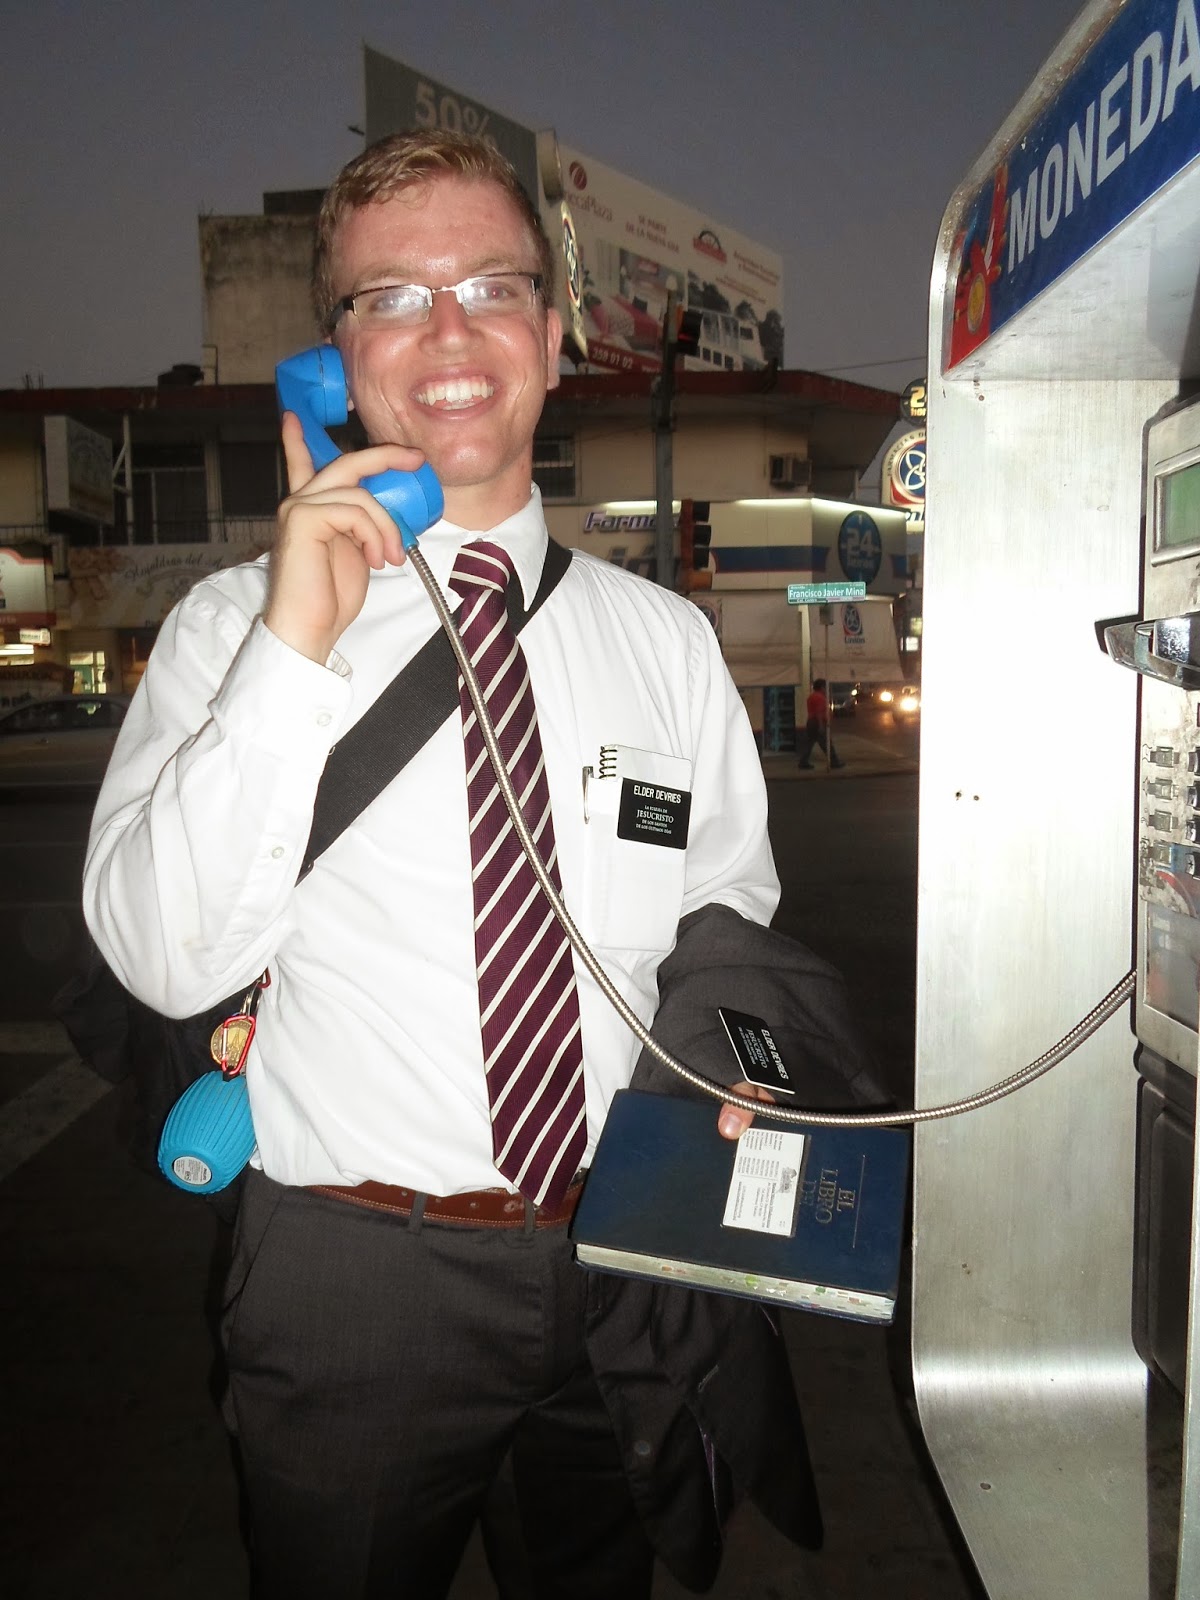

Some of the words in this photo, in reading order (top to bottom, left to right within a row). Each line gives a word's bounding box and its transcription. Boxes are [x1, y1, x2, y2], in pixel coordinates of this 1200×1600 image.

[1007, 0, 1200, 272] MONEDA
[910, 386, 926, 408] 2
[847, 528, 873, 557] 24
[789, 588, 822, 599] Francisco
[823, 588, 844, 598] Javier
[846, 587, 864, 596] Mina
[634, 785, 654, 798] ELDER
[655, 790, 682, 804] DEVRIES
[636, 810, 674, 824] JESUCRISTO
[761, 1029, 776, 1051] ELDER
[771, 1051, 789, 1080] DEVRIES
[815, 1168, 839, 1224] LIBRO
[836, 1187, 856, 1212] EL
